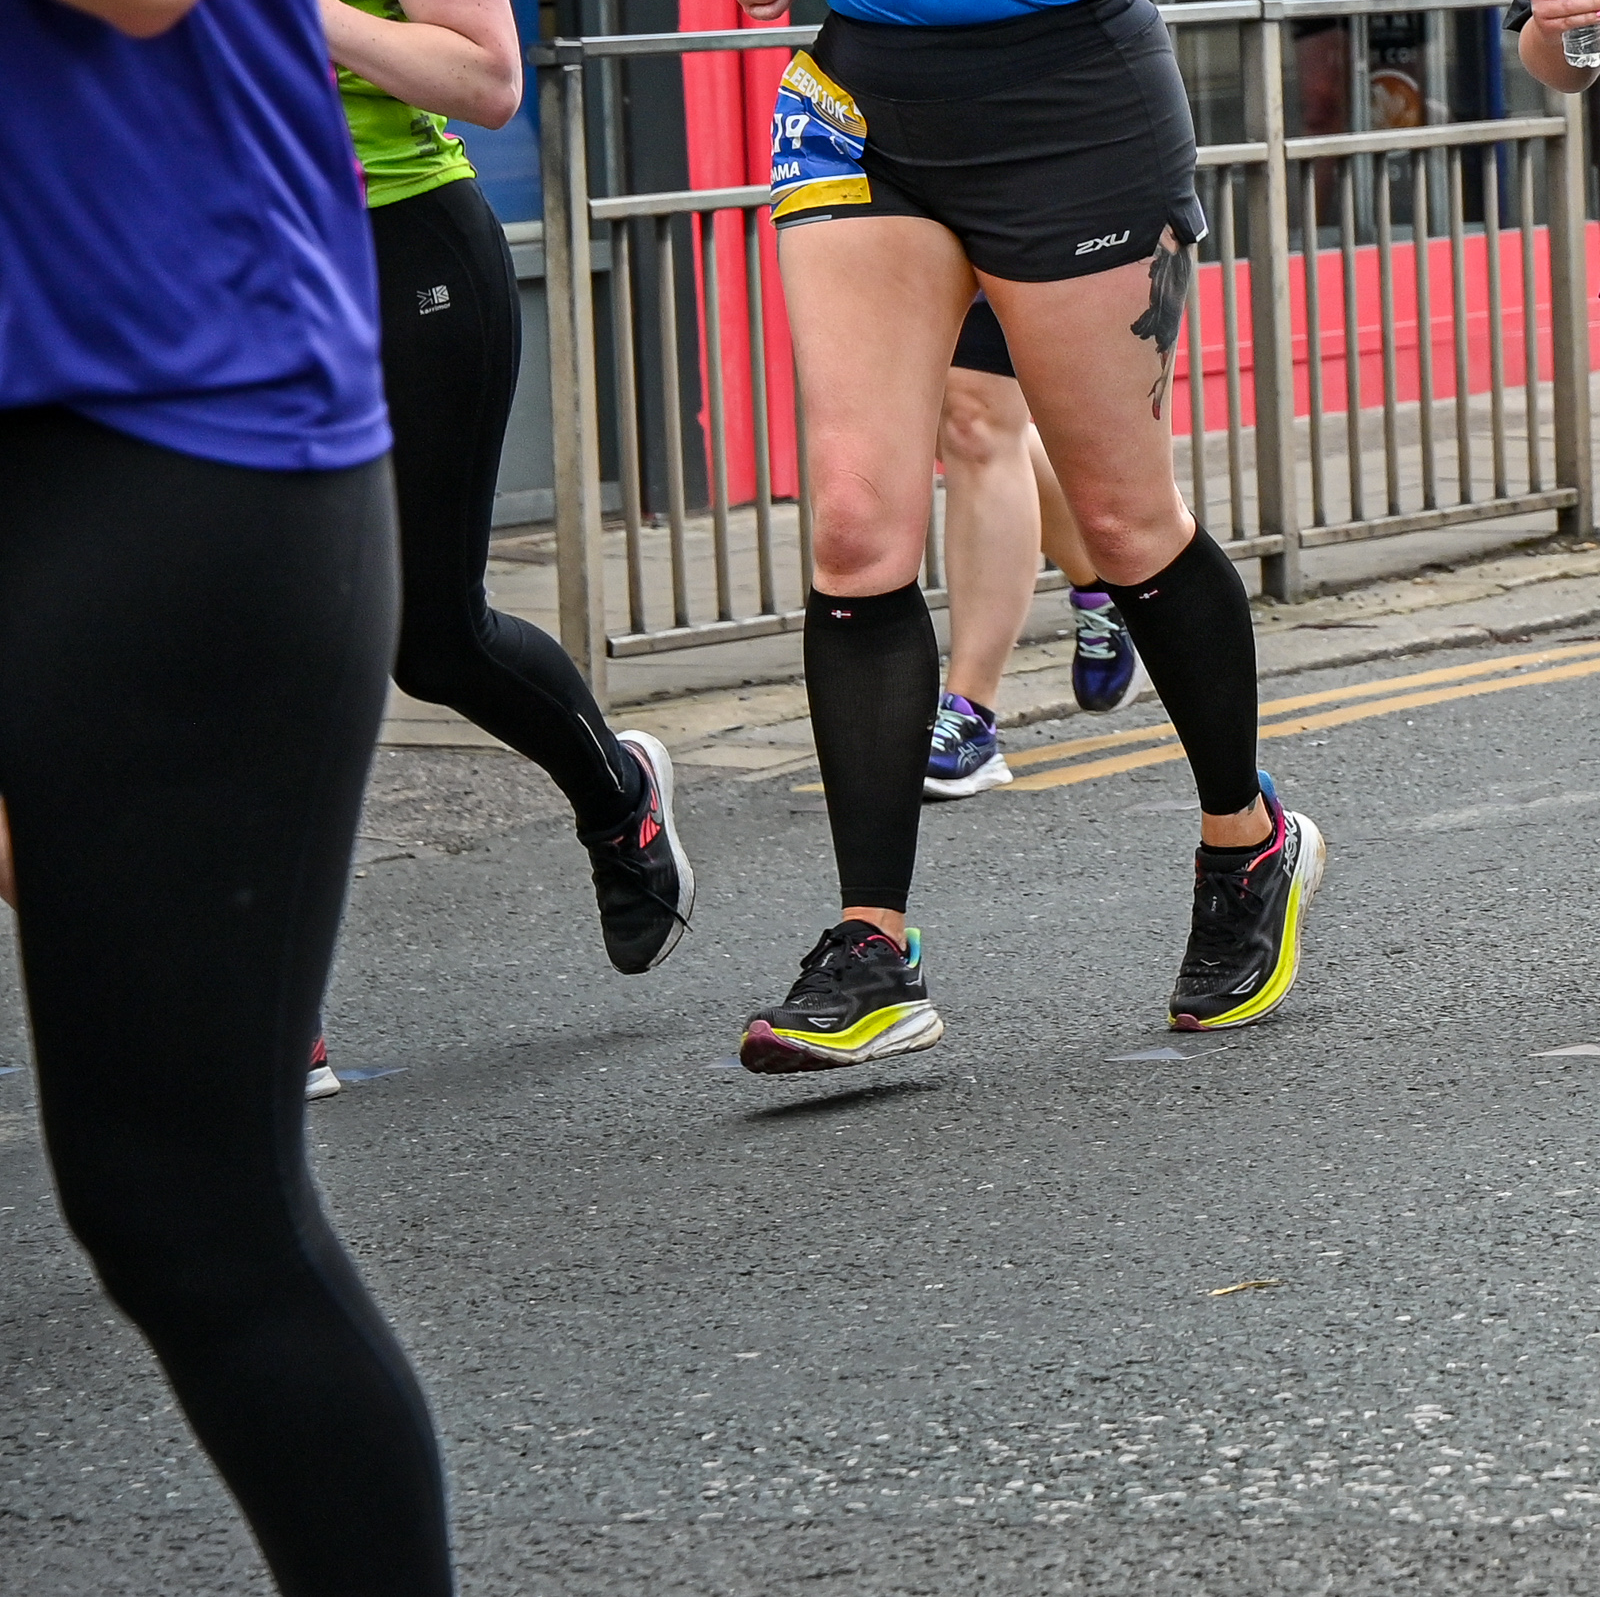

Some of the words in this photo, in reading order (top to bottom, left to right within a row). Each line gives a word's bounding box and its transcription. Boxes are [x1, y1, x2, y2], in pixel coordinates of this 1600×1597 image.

[782, 61, 822, 103] LEEDS
[821, 90, 849, 123] 10K
[1075, 230, 1130, 257] 2XU
